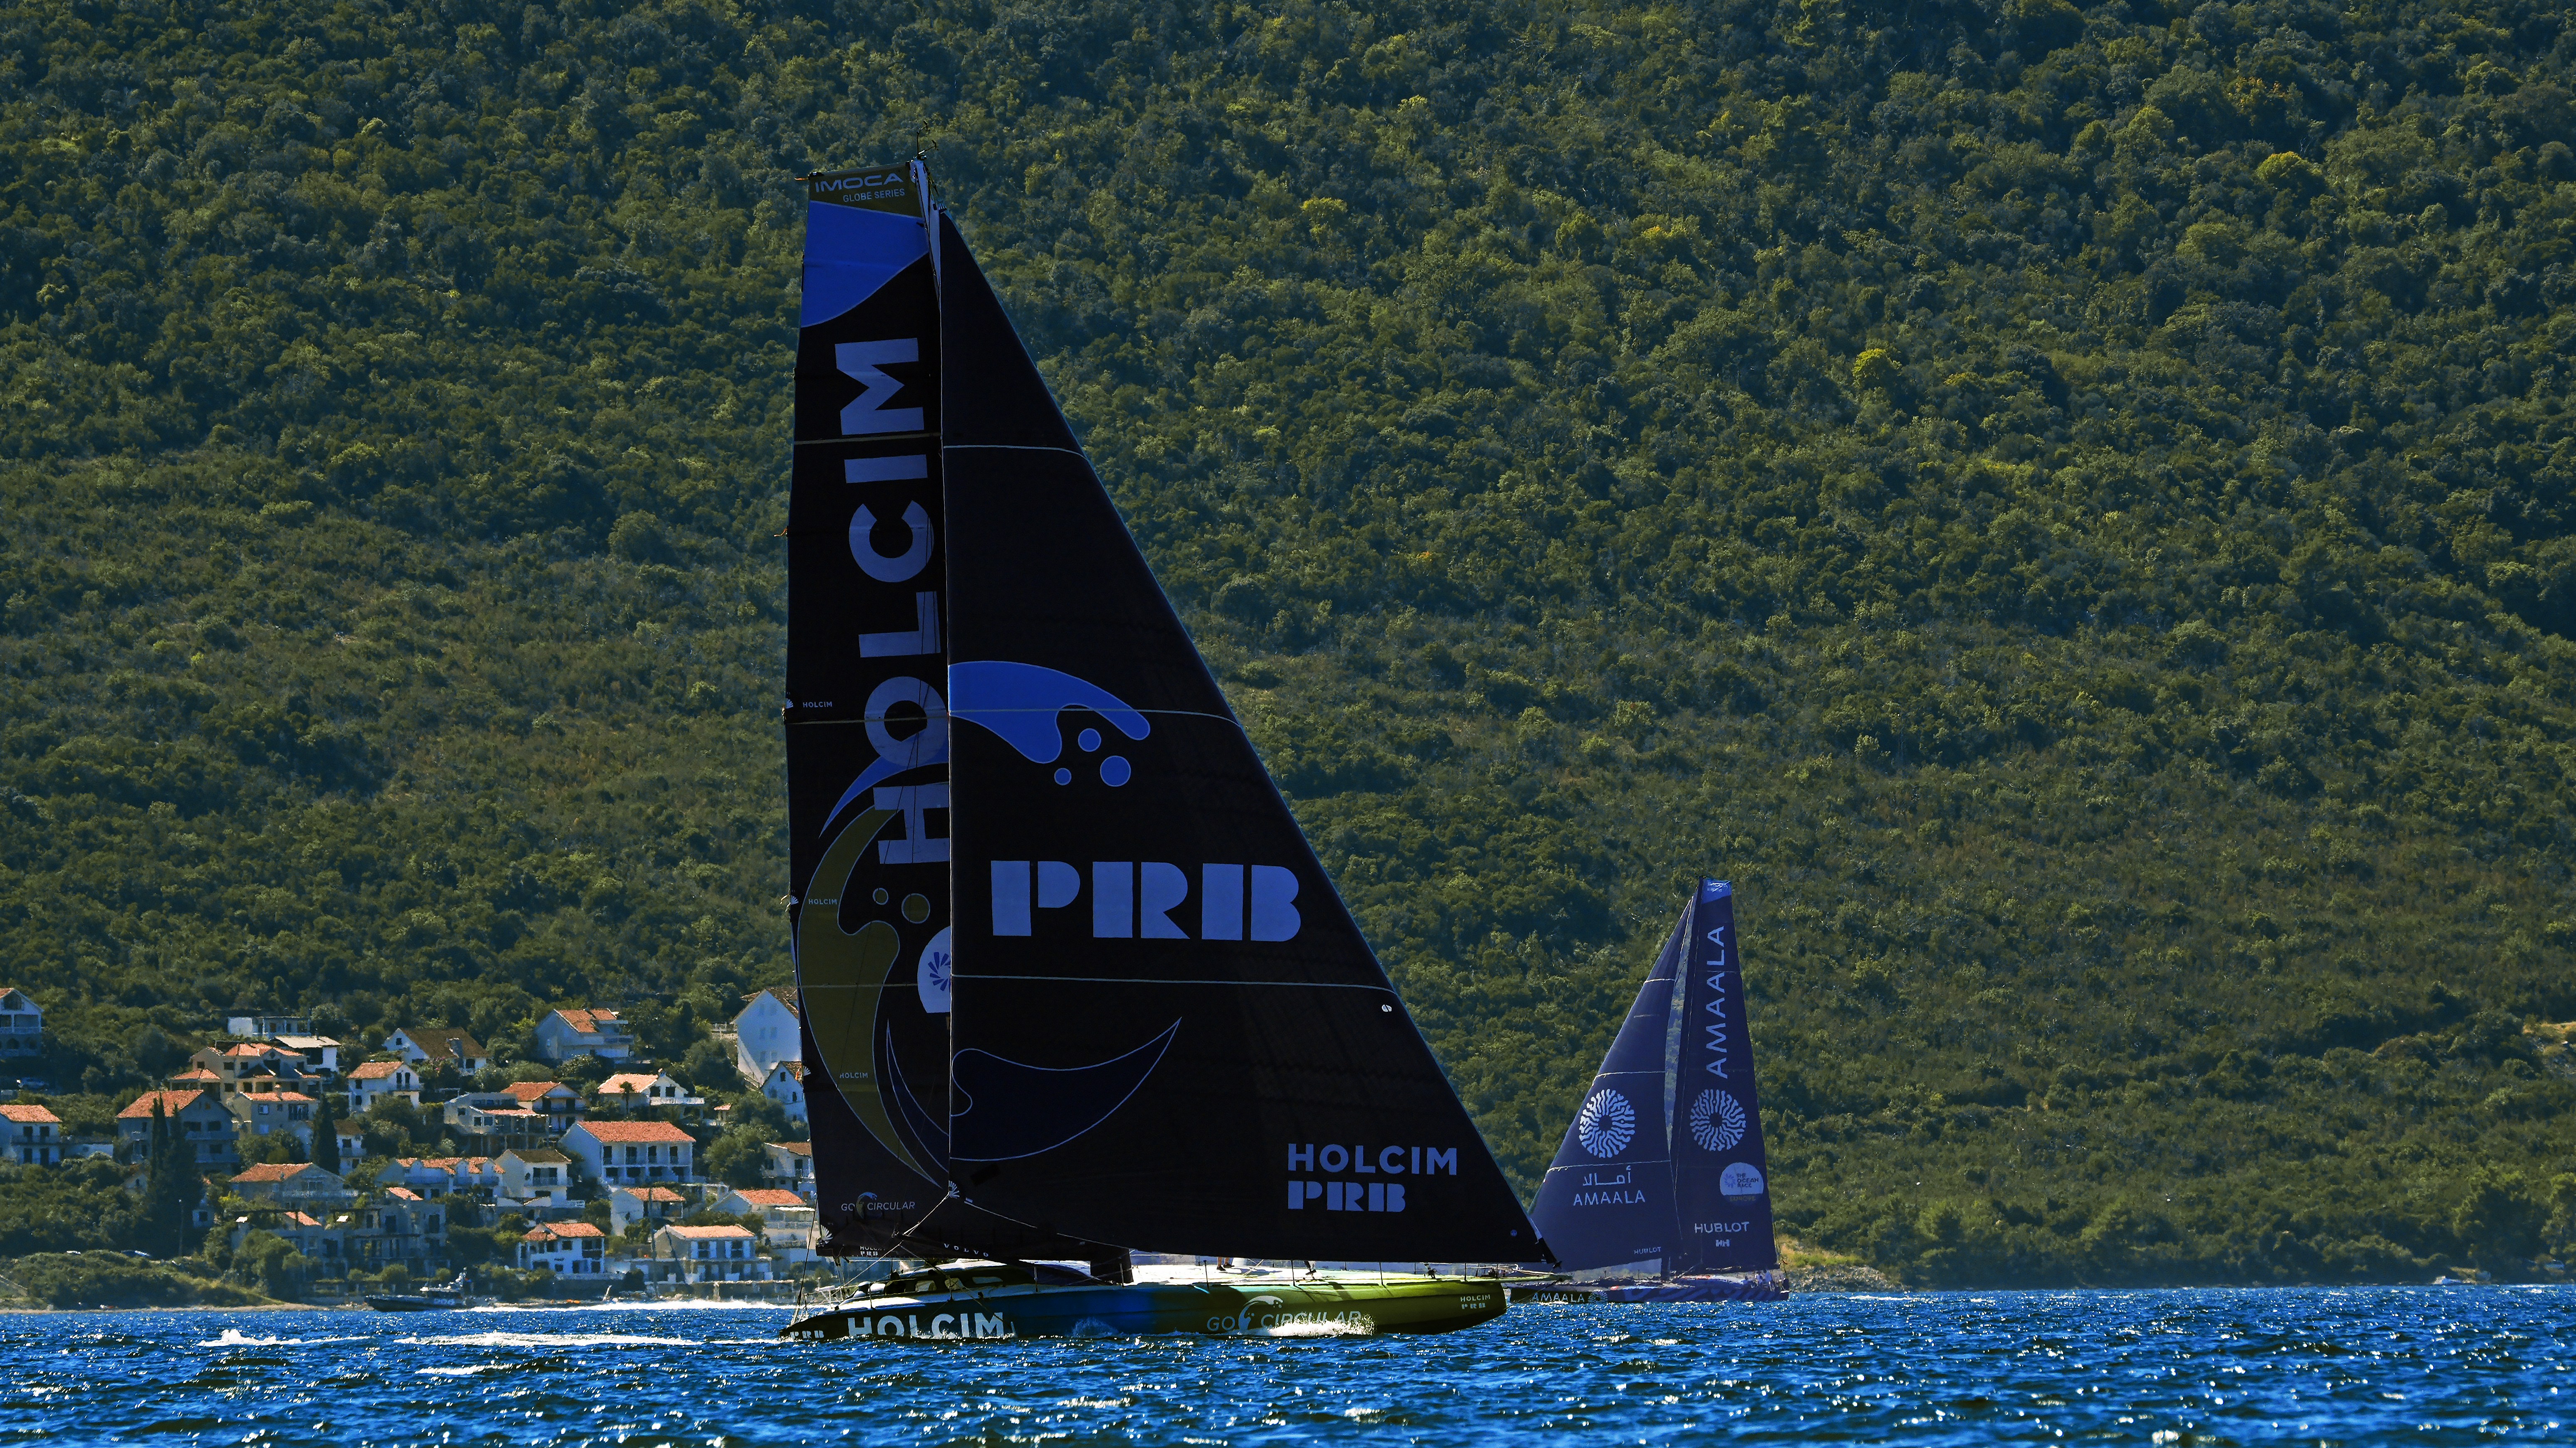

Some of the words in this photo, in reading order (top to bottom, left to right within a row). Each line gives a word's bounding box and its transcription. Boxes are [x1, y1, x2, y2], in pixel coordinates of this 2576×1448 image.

[815, 173, 904, 193] IMOCA
[843, 192, 872, 203] GLOBE
[874, 188, 905, 199] SERIES
[835, 337, 950, 864] HOLCIM
[991, 860, 1301, 942] PRB
[1706, 925, 1728, 1079] AMAALA
[1288, 1143, 1457, 1176] HOLCIM
[1288, 1180, 1406, 1212] PRB
[1573, 1190, 1646, 1206] AMAALA
[841, 1203, 855, 1211] GO
[867, 1201, 916, 1211] CIRCULAR
[1694, 1221, 1750, 1234] HUBLOT
[943, 1242, 989, 1258] VOLVO
[1634, 1246, 1662, 1255] HUBLOT
[1532, 1292, 1585, 1303] AMAALA
[847, 1312, 1004, 1339] HOLCIM
[1207, 1316, 1236, 1331] GO
